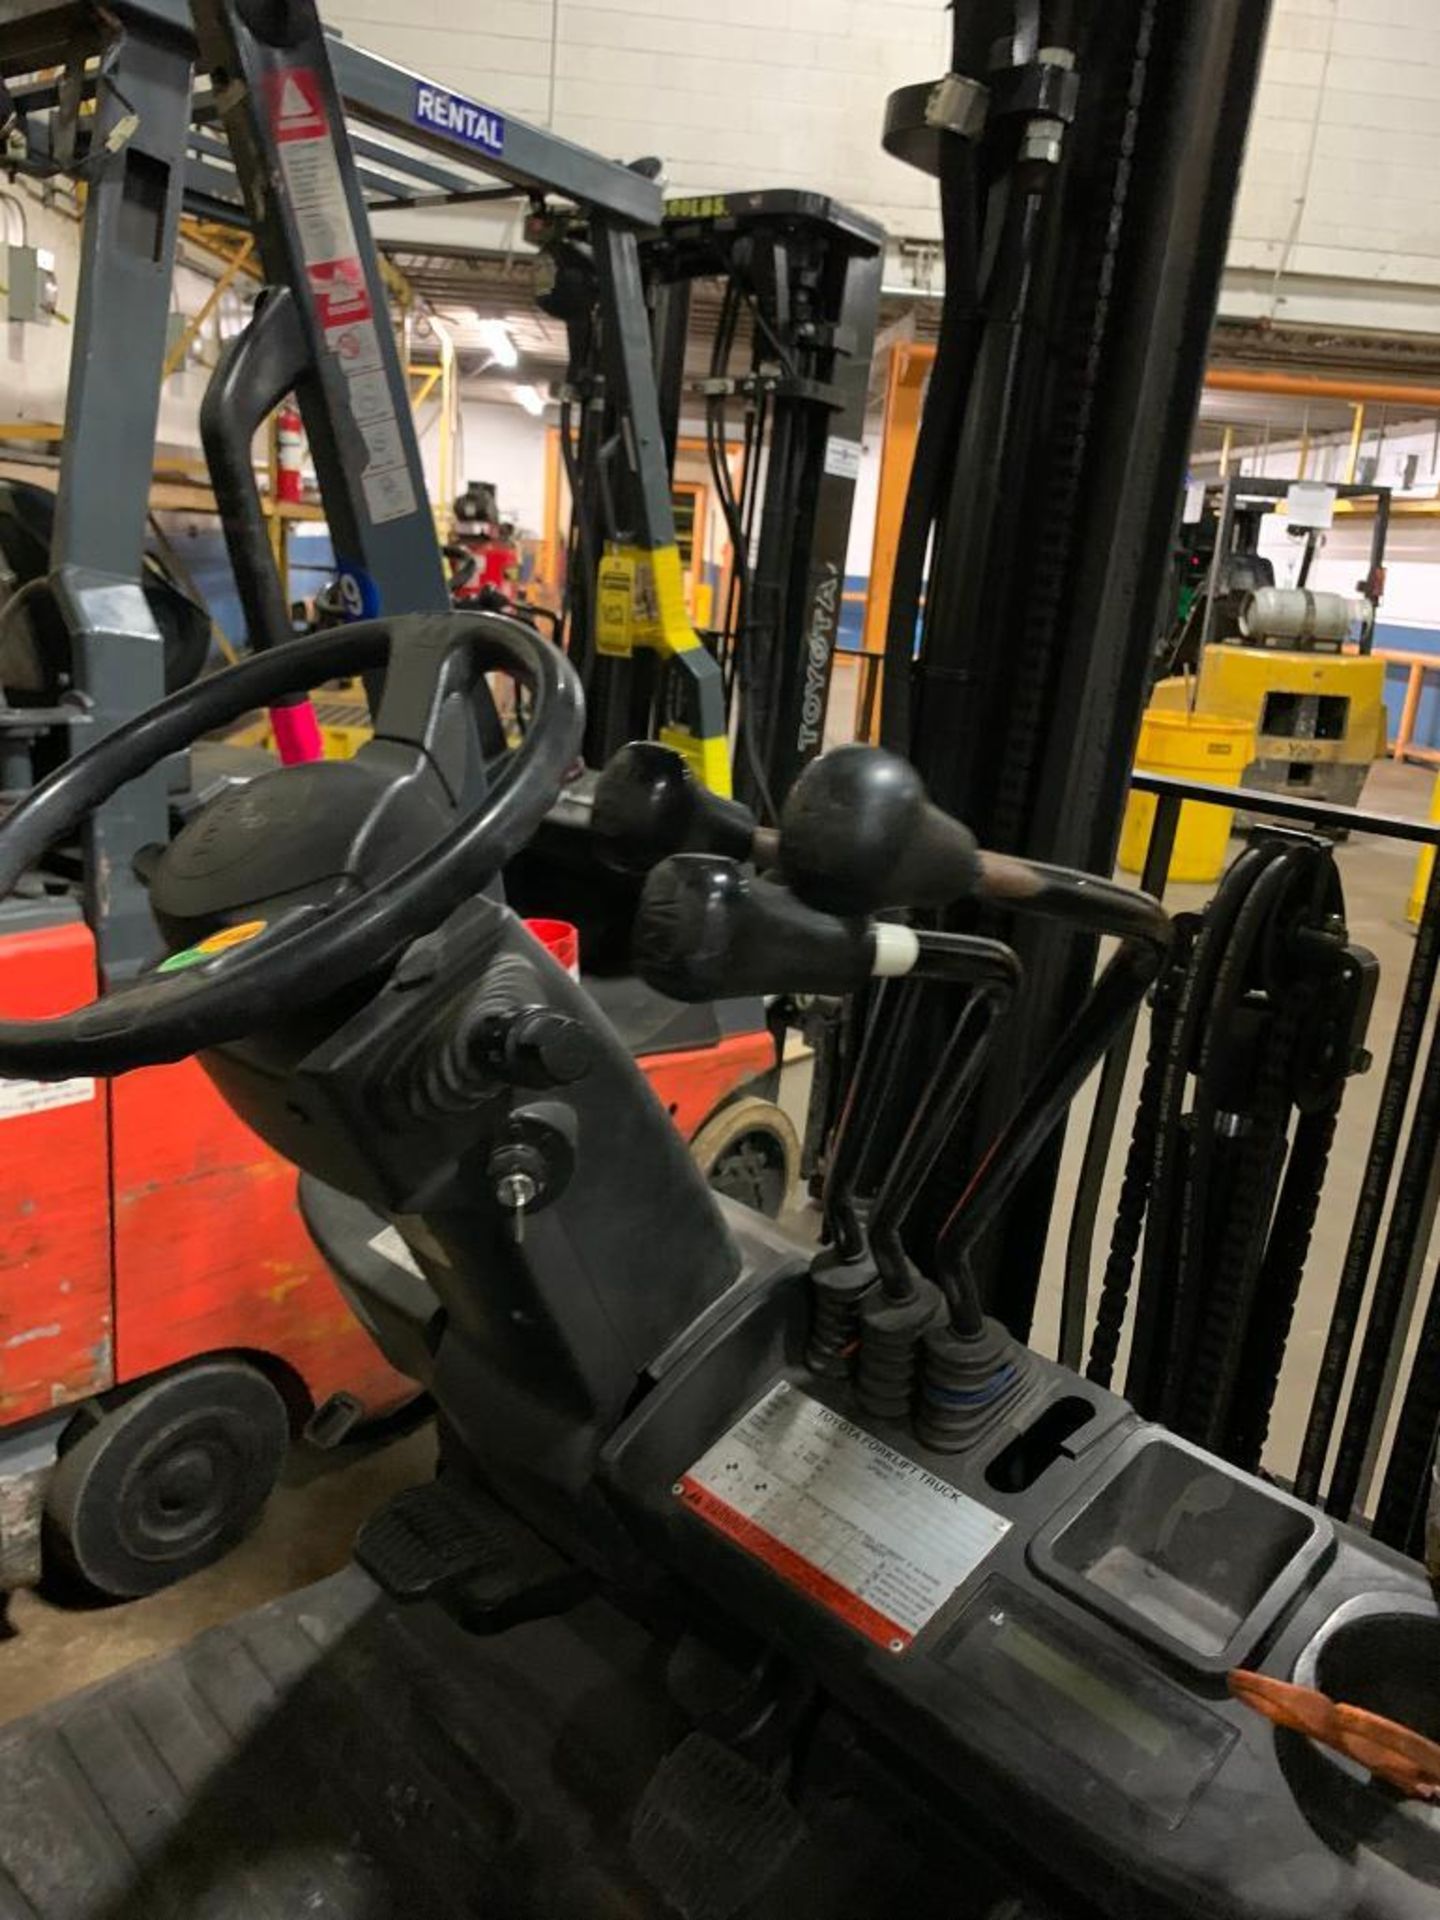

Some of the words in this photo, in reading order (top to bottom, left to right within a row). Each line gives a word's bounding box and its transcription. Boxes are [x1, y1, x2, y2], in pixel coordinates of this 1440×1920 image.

[417, 89, 503, 149] RENTAL
[798, 578, 839, 752] TOYOTA
[817, 1408, 861, 1441] TOYOTA
[861, 1435, 920, 1476] FORKLIFT
[918, 1471, 963, 1504] TRUCK
